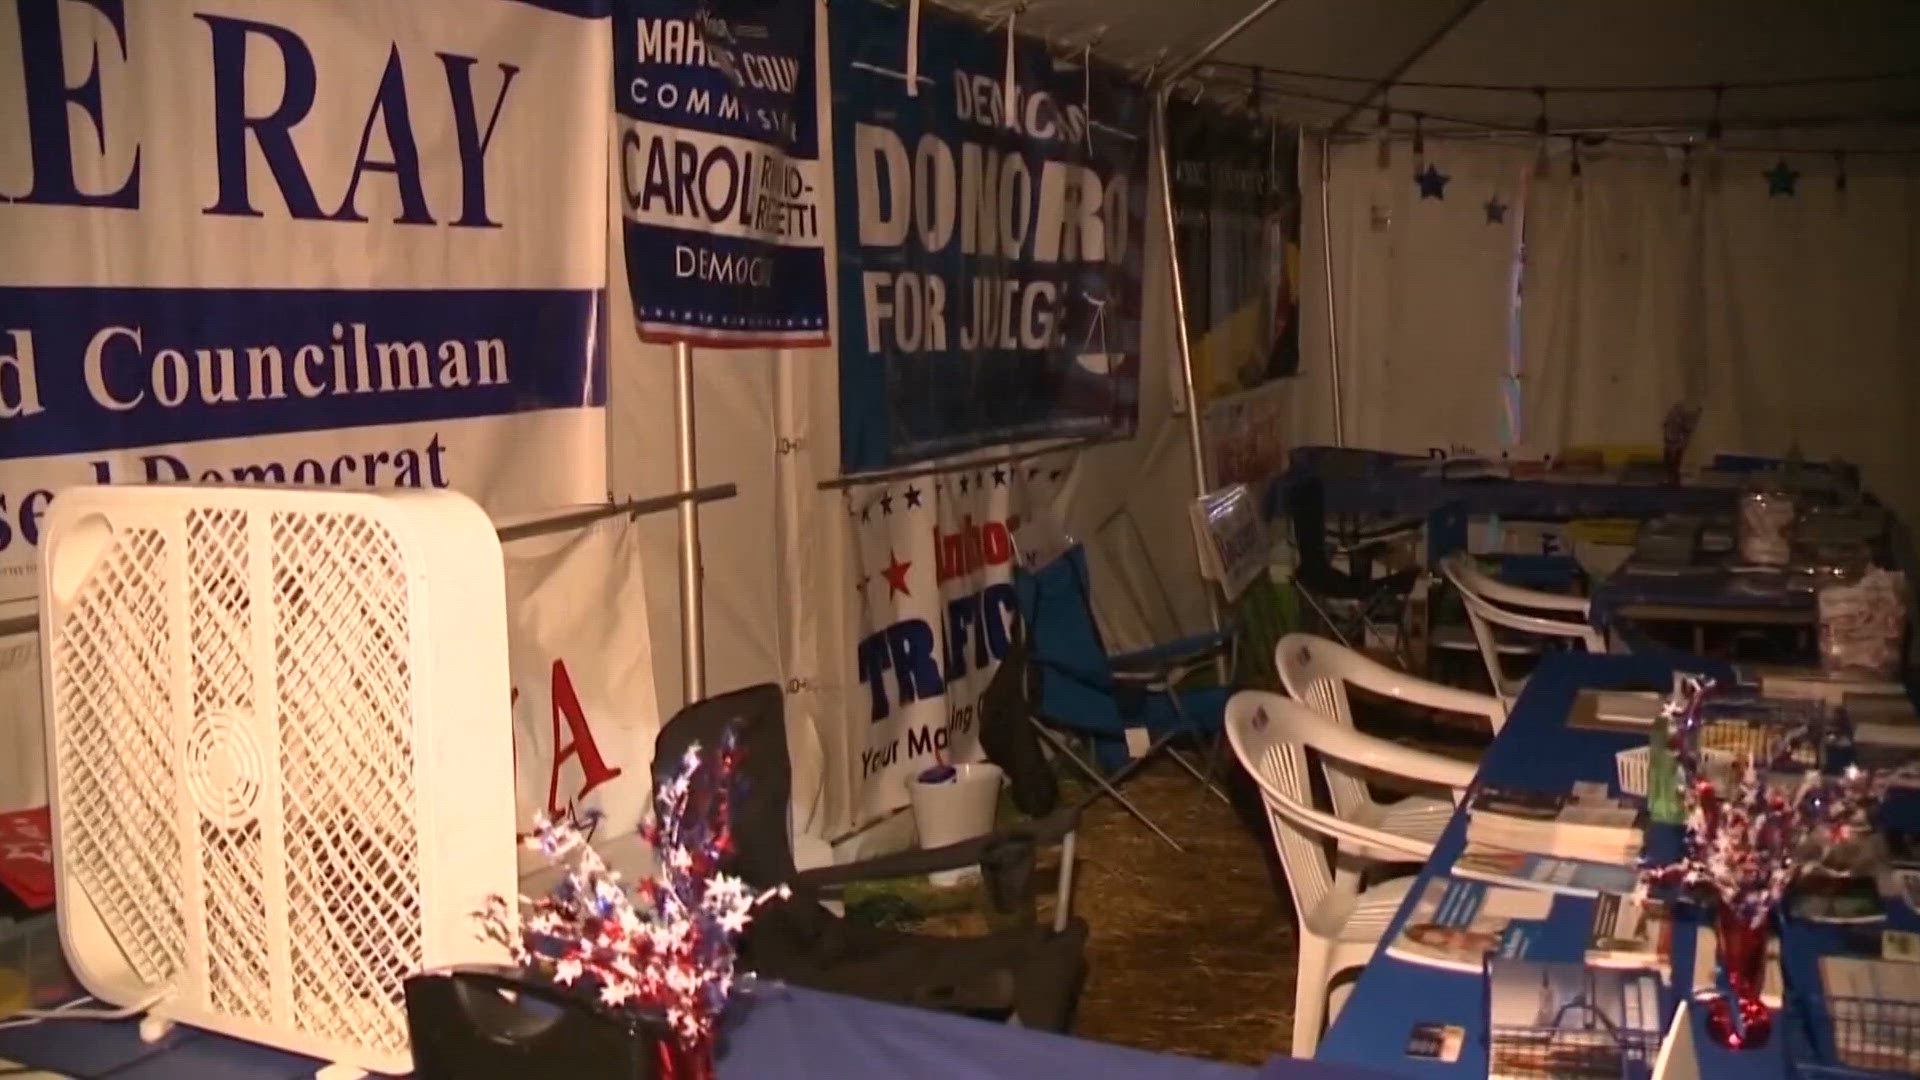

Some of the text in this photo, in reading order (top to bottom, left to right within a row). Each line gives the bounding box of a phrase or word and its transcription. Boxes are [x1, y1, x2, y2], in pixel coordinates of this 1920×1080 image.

[0, 0, 520, 229] E RAY
[621, 128, 754, 227] CAROL
[862, 270, 948, 353] FOR
[83, 322, 511, 412] Councilman
[861, 739, 899, 781] Your
